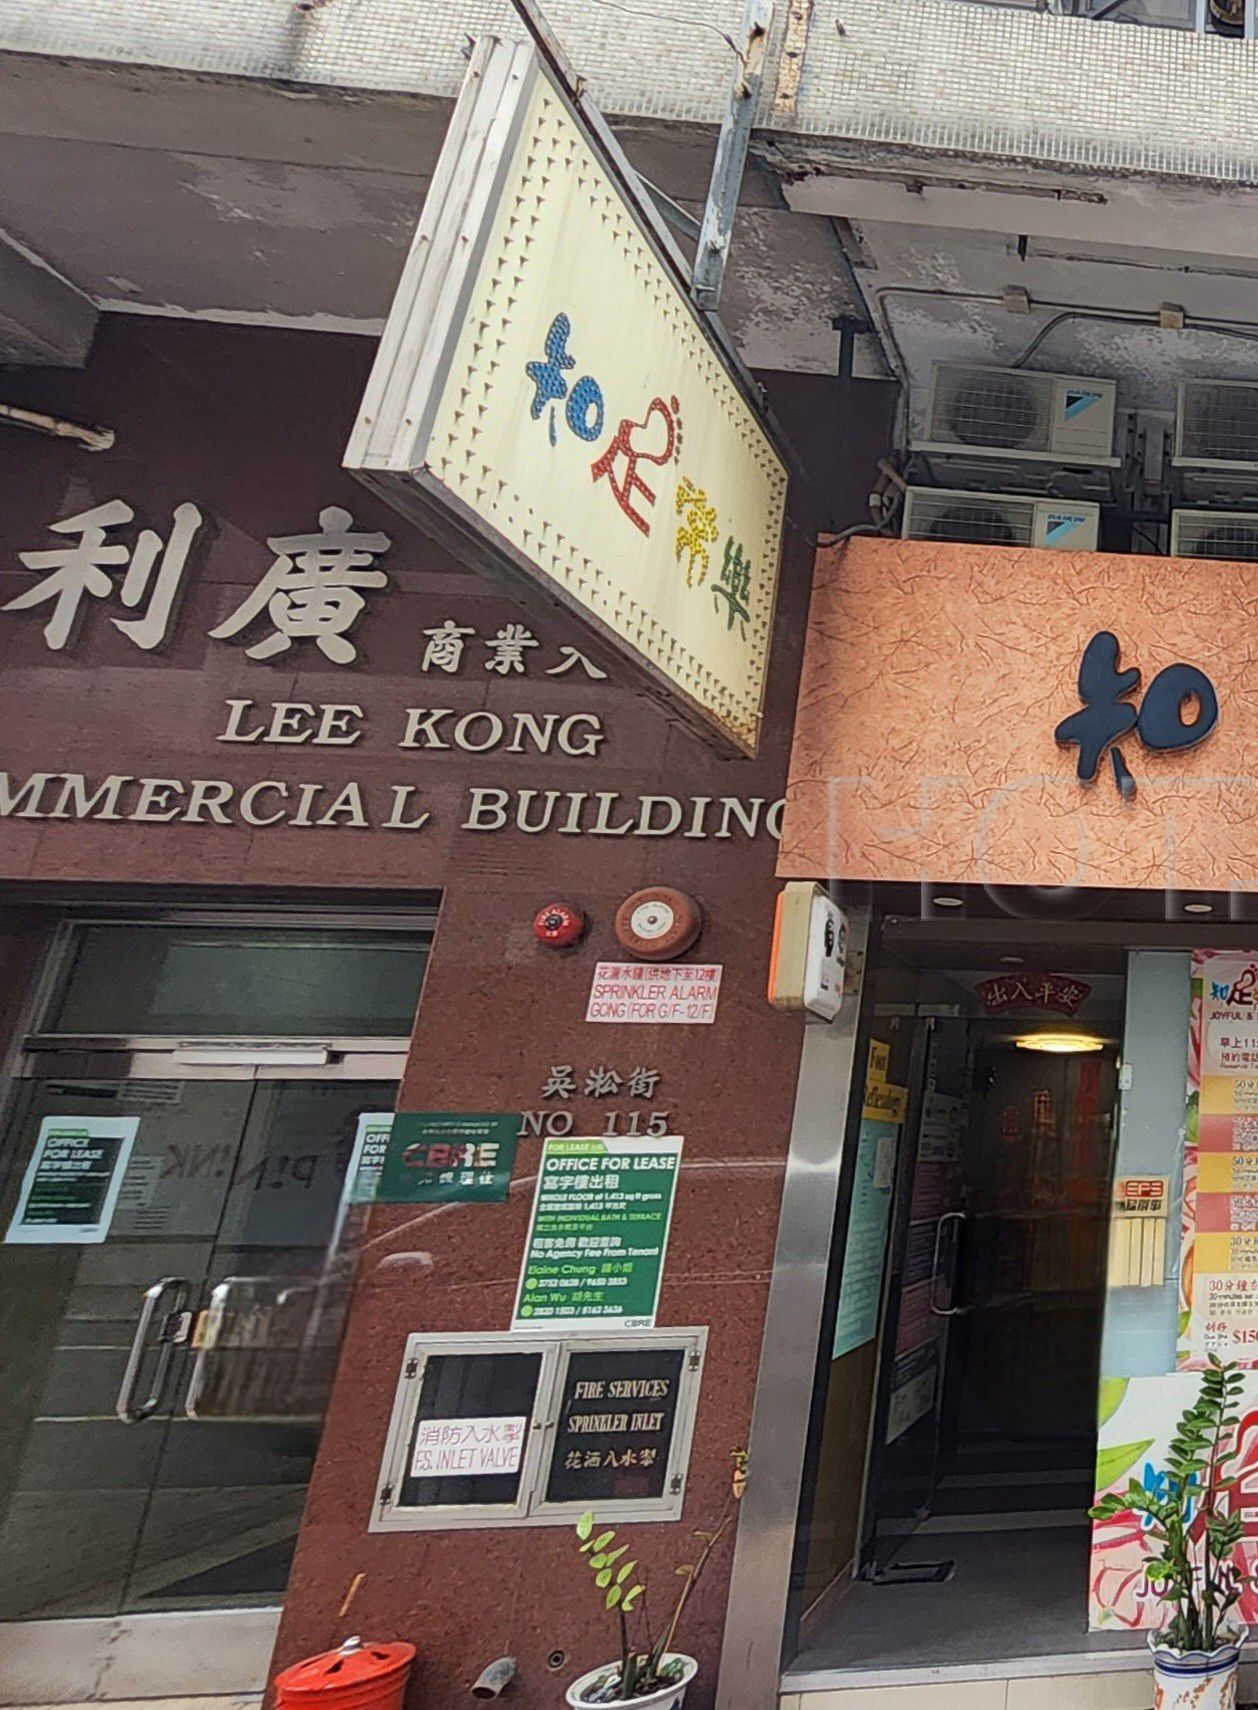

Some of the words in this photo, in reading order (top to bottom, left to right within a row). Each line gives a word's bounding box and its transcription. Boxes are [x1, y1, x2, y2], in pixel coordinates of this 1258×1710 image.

[217, 700, 364, 746] LEE
[400, 707, 605, 755] KONG
[593, 984, 666, 1000] SPRINKLER
[669, 985, 717, 1000] ALARM
[986, 981, 1082, 1007] 出入平安
[590, 1003, 625, 1018] GONG
[516, 1111, 574, 1137] NO
[602, 1111, 670, 1137] 115
[546, 1157, 599, 1171] OFFICE
[600, 1156, 631, 1171] FOR
[633, 1156, 676, 1170] LEASE
[1126, 1181, 1162, 1196] EPS
[574, 1381, 604, 1399] FIRE
[608, 1379, 670, 1398] SERVICES
[567, 1414, 628, 1433] SPRINKLER
[630, 1412, 665, 1432] INLET
[436, 1448, 478, 1470] INLET
[480, 1446, 519, 1468] VALVE
